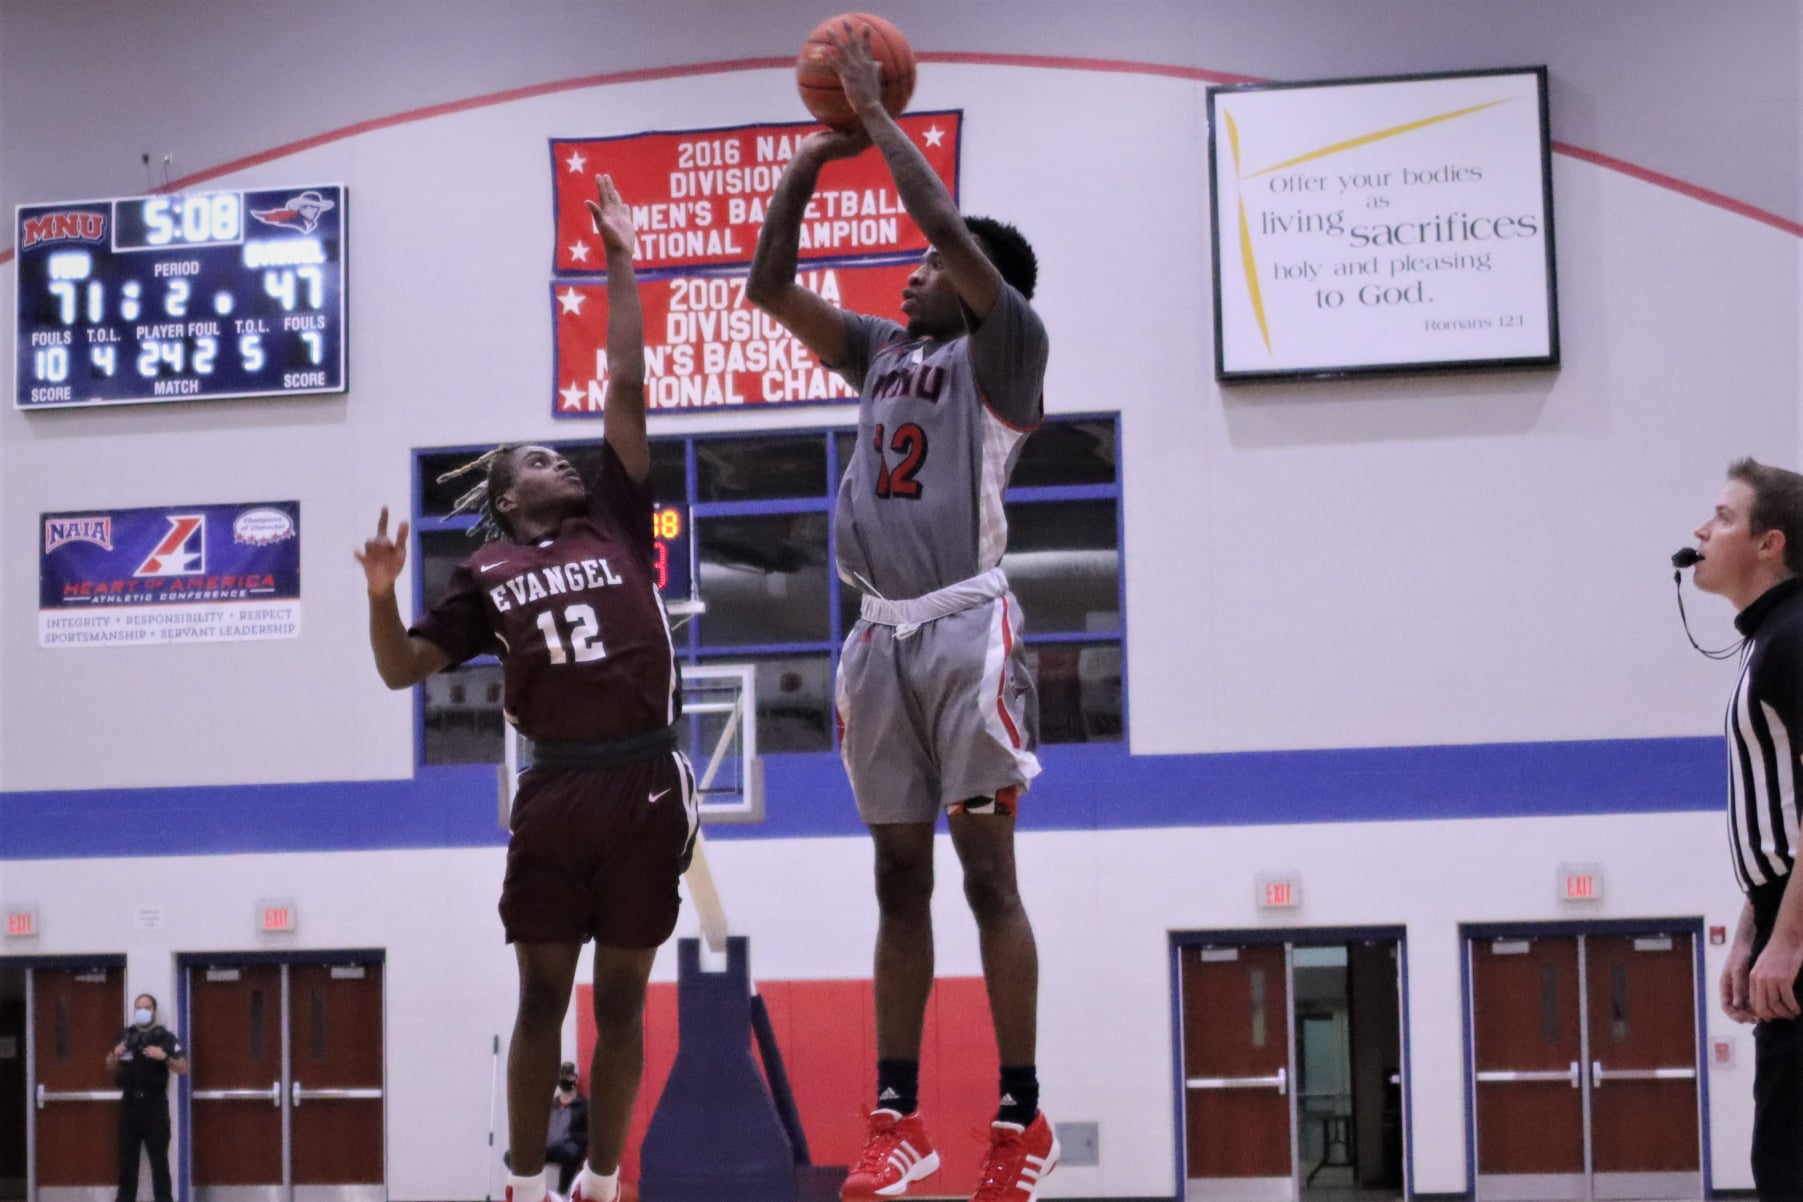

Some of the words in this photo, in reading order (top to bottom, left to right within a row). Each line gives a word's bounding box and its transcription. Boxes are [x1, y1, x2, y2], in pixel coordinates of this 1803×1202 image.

[677, 138, 741, 169] 2016
[756, 132, 803, 163] NAI
[1269, 173, 1327, 193] Offer
[1338, 171, 1392, 194] your
[1402, 165, 1483, 185] bodies
[1366, 195, 1390, 209] as
[22, 213, 104, 248] MNU
[143, 197, 239, 245] 5:08
[1262, 209, 1345, 237] living
[1349, 211, 1538, 248] sacrifices
[632, 228, 742, 262] ATIONAL
[154, 261, 199, 277] PERIOD
[1274, 260, 1321, 282] holy
[1333, 255, 1378, 276] and
[1390, 251, 1493, 278] pleasing
[49, 280, 103, 325] 71
[164, 278, 190, 317] 2
[264, 266, 323, 311] 47
[669, 278, 748, 311] 2007
[1315, 288, 1344, 309] to
[1358, 281, 1434, 306] God.
[86, 328, 121, 343] T.O.L.
[136, 324, 184, 340] PLAYER
[188, 321, 220, 337] FOUL
[235, 319, 270, 334] T.O.L.
[283, 315, 325, 331] FOULS
[666, 309, 793, 345] DIVISIO
[1424, 319, 1493, 331] Romans
[31, 331, 72, 346] FOULS
[239, 334, 264, 372] 5
[301, 331, 323, 365] 7
[35, 349, 69, 382] 10
[91, 345, 117, 377] 4
[31, 387, 71, 402] SCORE
[154, 380, 199, 395] MATCH
[283, 372, 325, 388] SCORE
[588, 372, 744, 412] NIONAL
[872, 422, 929, 500] 12
[48, 520, 107, 546] NAIA
[64, 579, 137, 596] HEART
[169, 574, 275, 591] AMERICA
[91, 593, 152, 604] ATHLETIC
[160, 589, 247, 600] CONFERENCE
[489, 558, 623, 612] EVANGEL
[47, 616, 110, 629] INTEGRITY
[126, 611, 224, 626] RESPONSIBILITY
[239, 608, 293, 621] RESPECT
[44, 629, 147, 644] SPORTSMANSHIP
[160, 627, 216, 640] SERVANT
[219, 623, 296, 637] LEADERSHIP
[536, 604, 607, 664] 12
[1265, 882, 1292, 905] EXIT
[1567, 874, 1593, 898] EXIT
